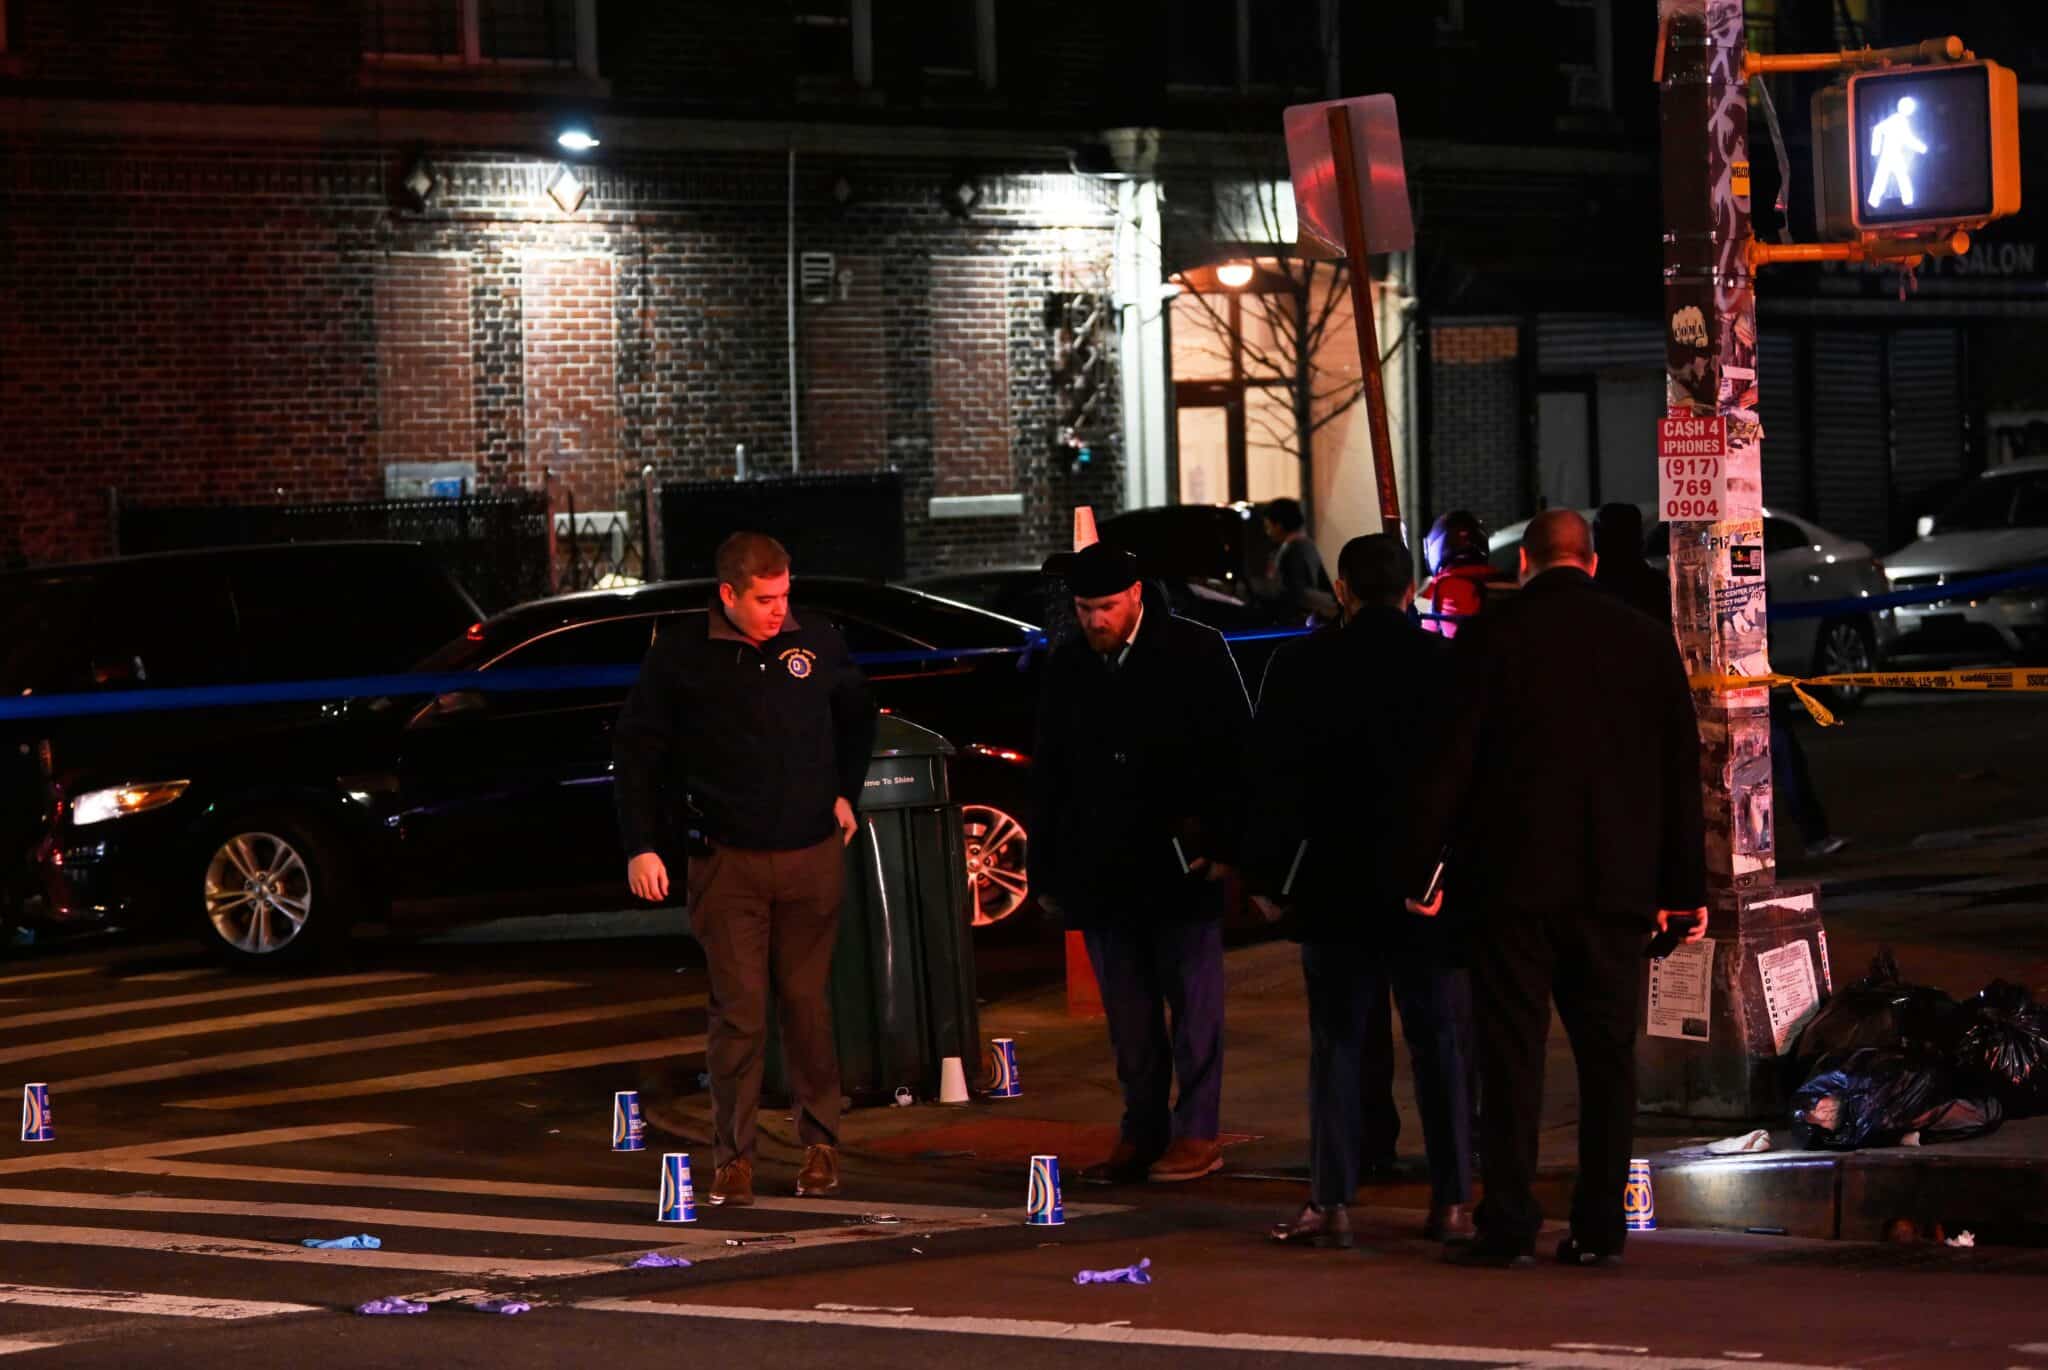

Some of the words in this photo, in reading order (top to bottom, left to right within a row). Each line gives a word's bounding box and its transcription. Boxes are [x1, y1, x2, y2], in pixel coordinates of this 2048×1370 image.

[1953, 242, 2036, 273] SALON
[1709, 420, 1719, 435] 4
[1664, 439, 1720, 454] IPHONES
[1666, 458, 1719, 479] (917)
[1673, 480, 1711, 496] 769
[1667, 500, 1719, 517] 0904
[1764, 970, 1773, 992] FOR
[1769, 997, 1779, 1026] RENT
